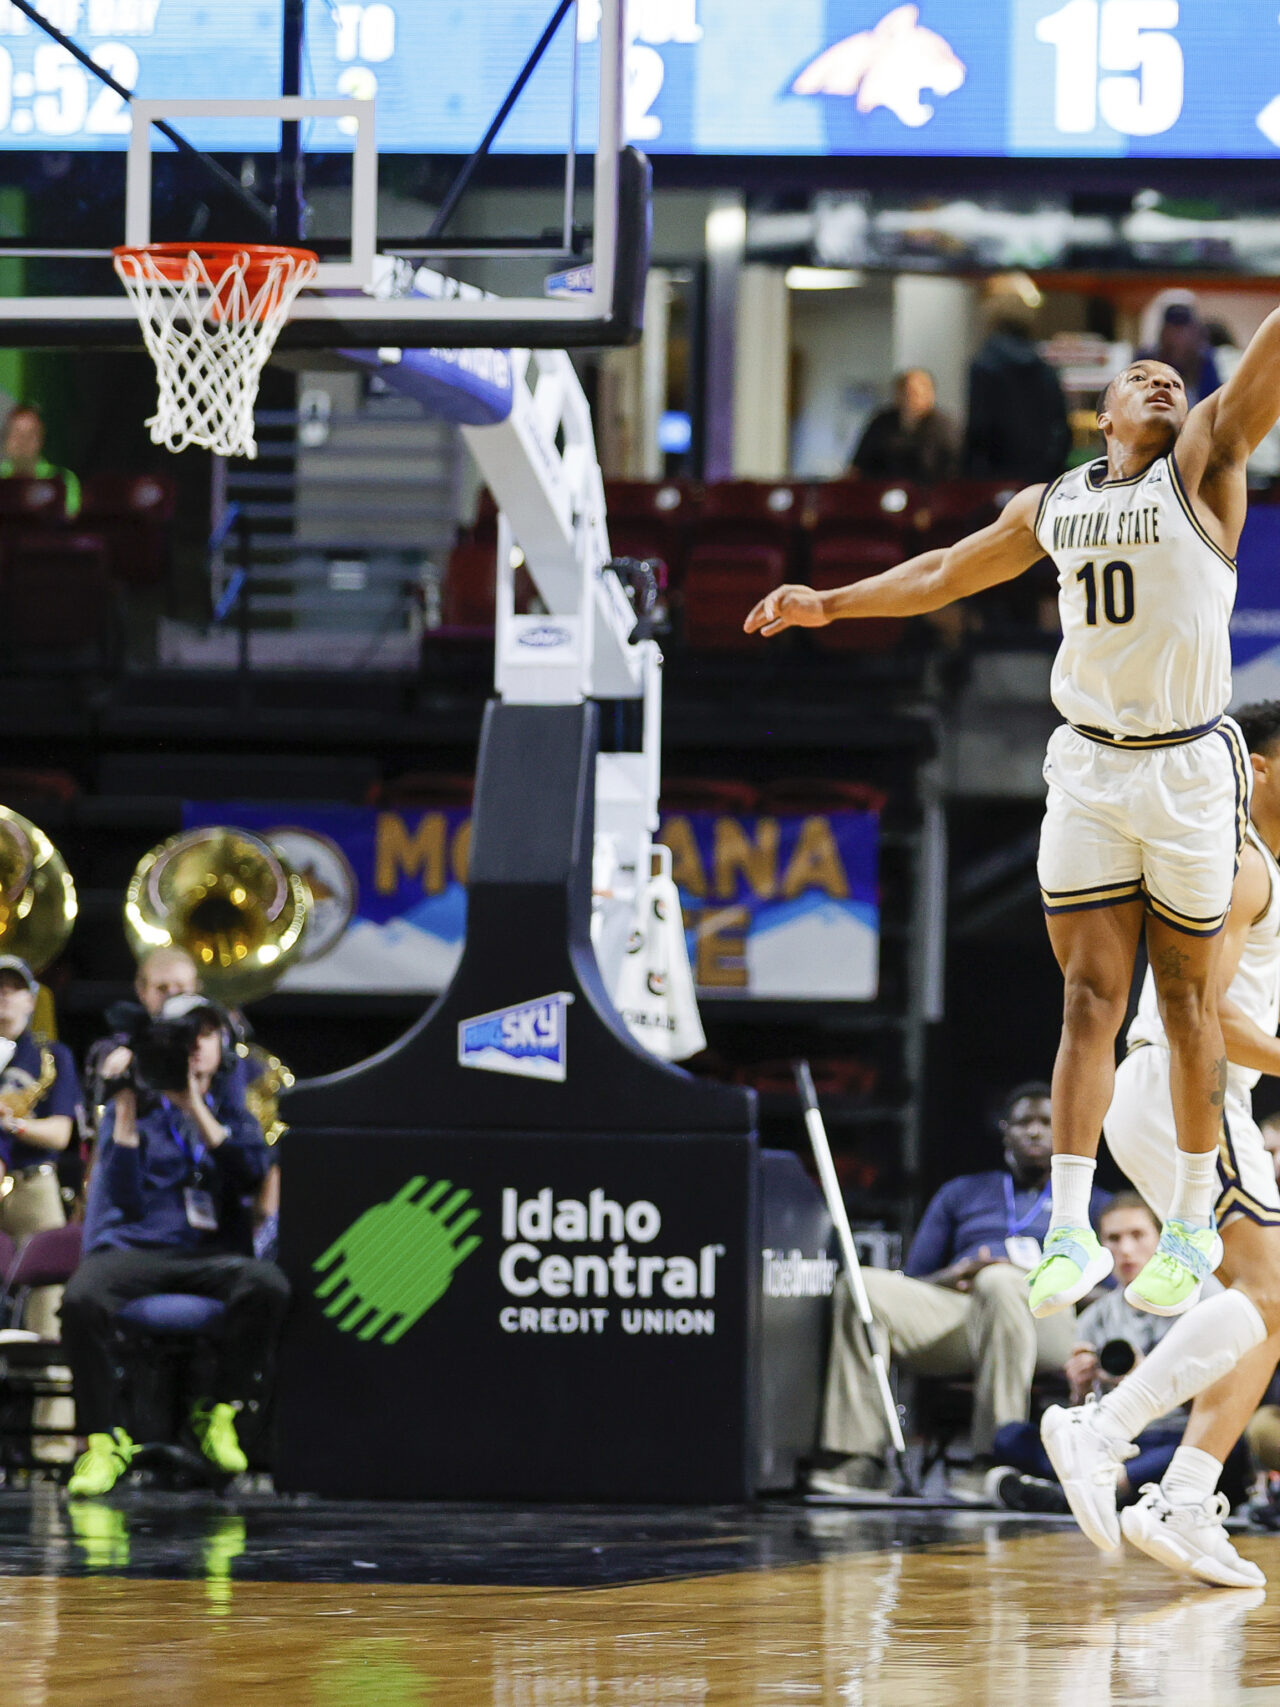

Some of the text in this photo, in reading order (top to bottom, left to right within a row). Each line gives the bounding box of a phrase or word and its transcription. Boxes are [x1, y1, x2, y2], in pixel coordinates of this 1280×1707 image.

[0, 42, 139, 135] :52
[1036, 0, 1184, 135] 15
[1053, 506, 1160, 551] MONTANA STATE
[1075, 559, 1136, 627] 10
[502, 1187, 662, 1243] Idaho
[499, 1243, 718, 1299] Central
[499, 1307, 716, 1336] CREDIT UNION
